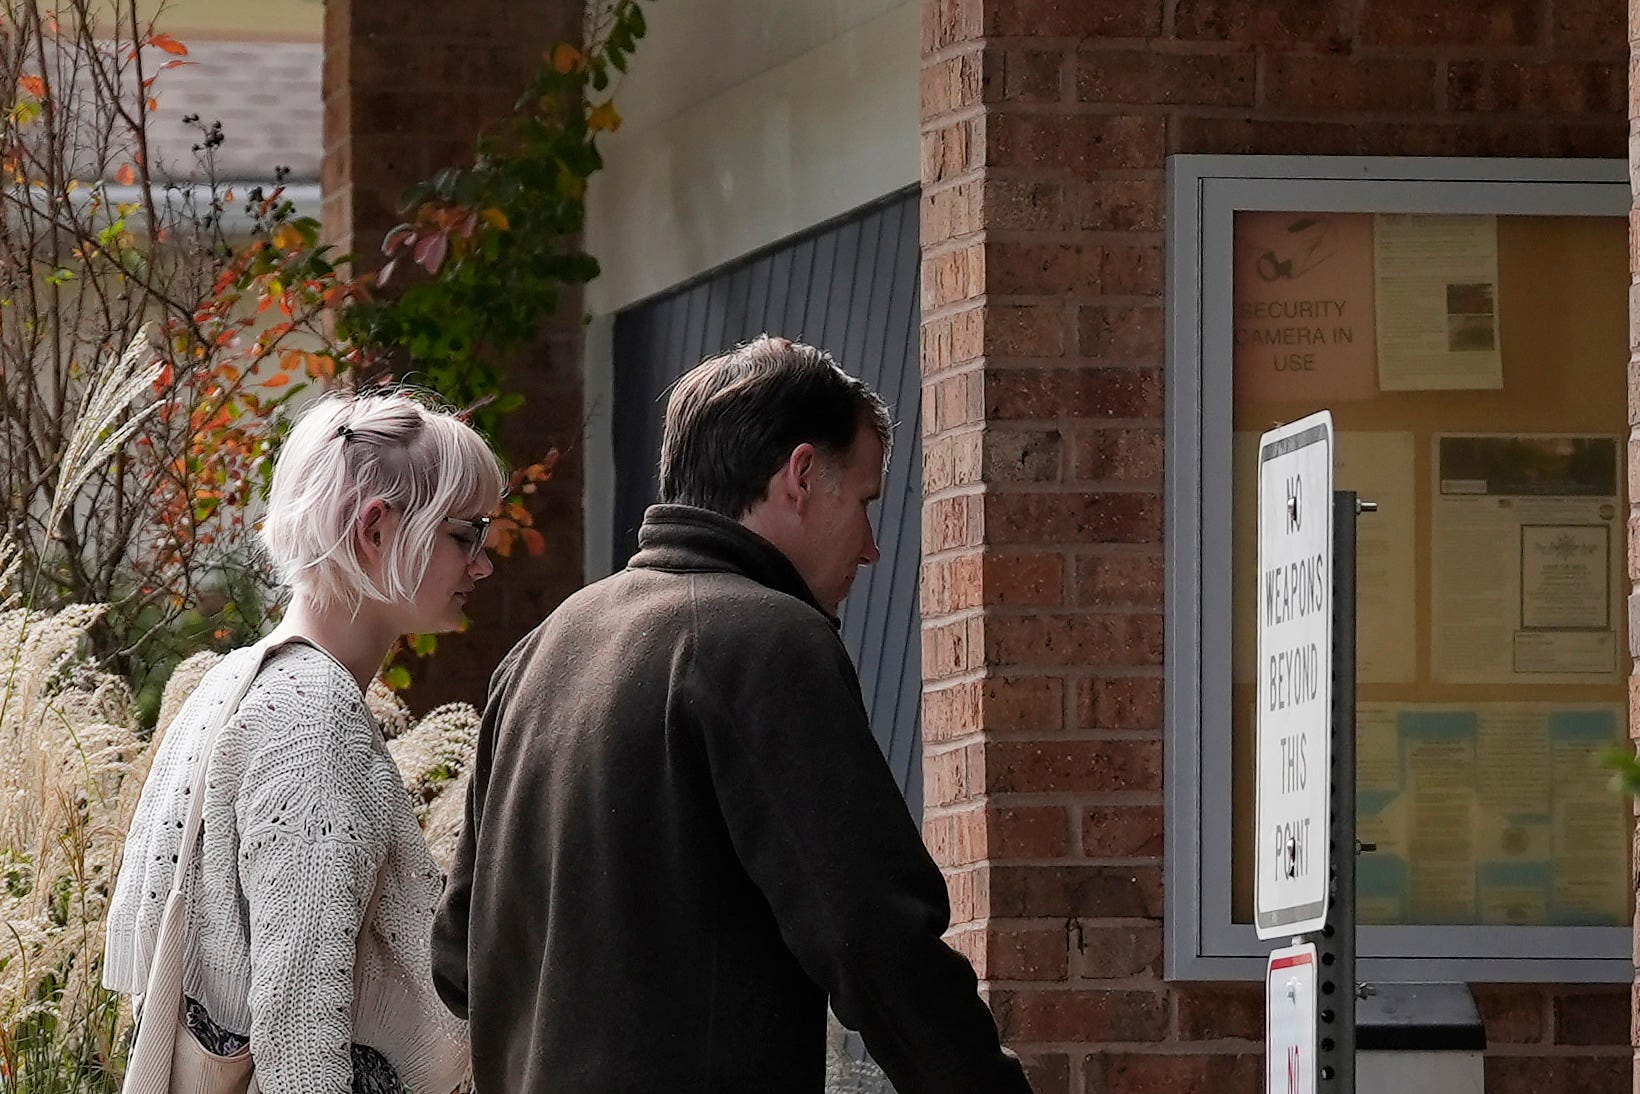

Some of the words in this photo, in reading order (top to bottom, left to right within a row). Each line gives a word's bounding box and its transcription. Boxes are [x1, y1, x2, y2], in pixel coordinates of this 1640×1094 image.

[1234, 326, 1327, 346] CAMERA
[1332, 326, 1354, 344] IN
[1239, 299, 1347, 320] SECURITY
[1273, 352, 1317, 372] USE
[1286, 472, 1303, 535] NO
[1265, 552, 1324, 628] WEAPONS
[1269, 642, 1318, 712] BEYOND
[1279, 731, 1308, 795] THIS
